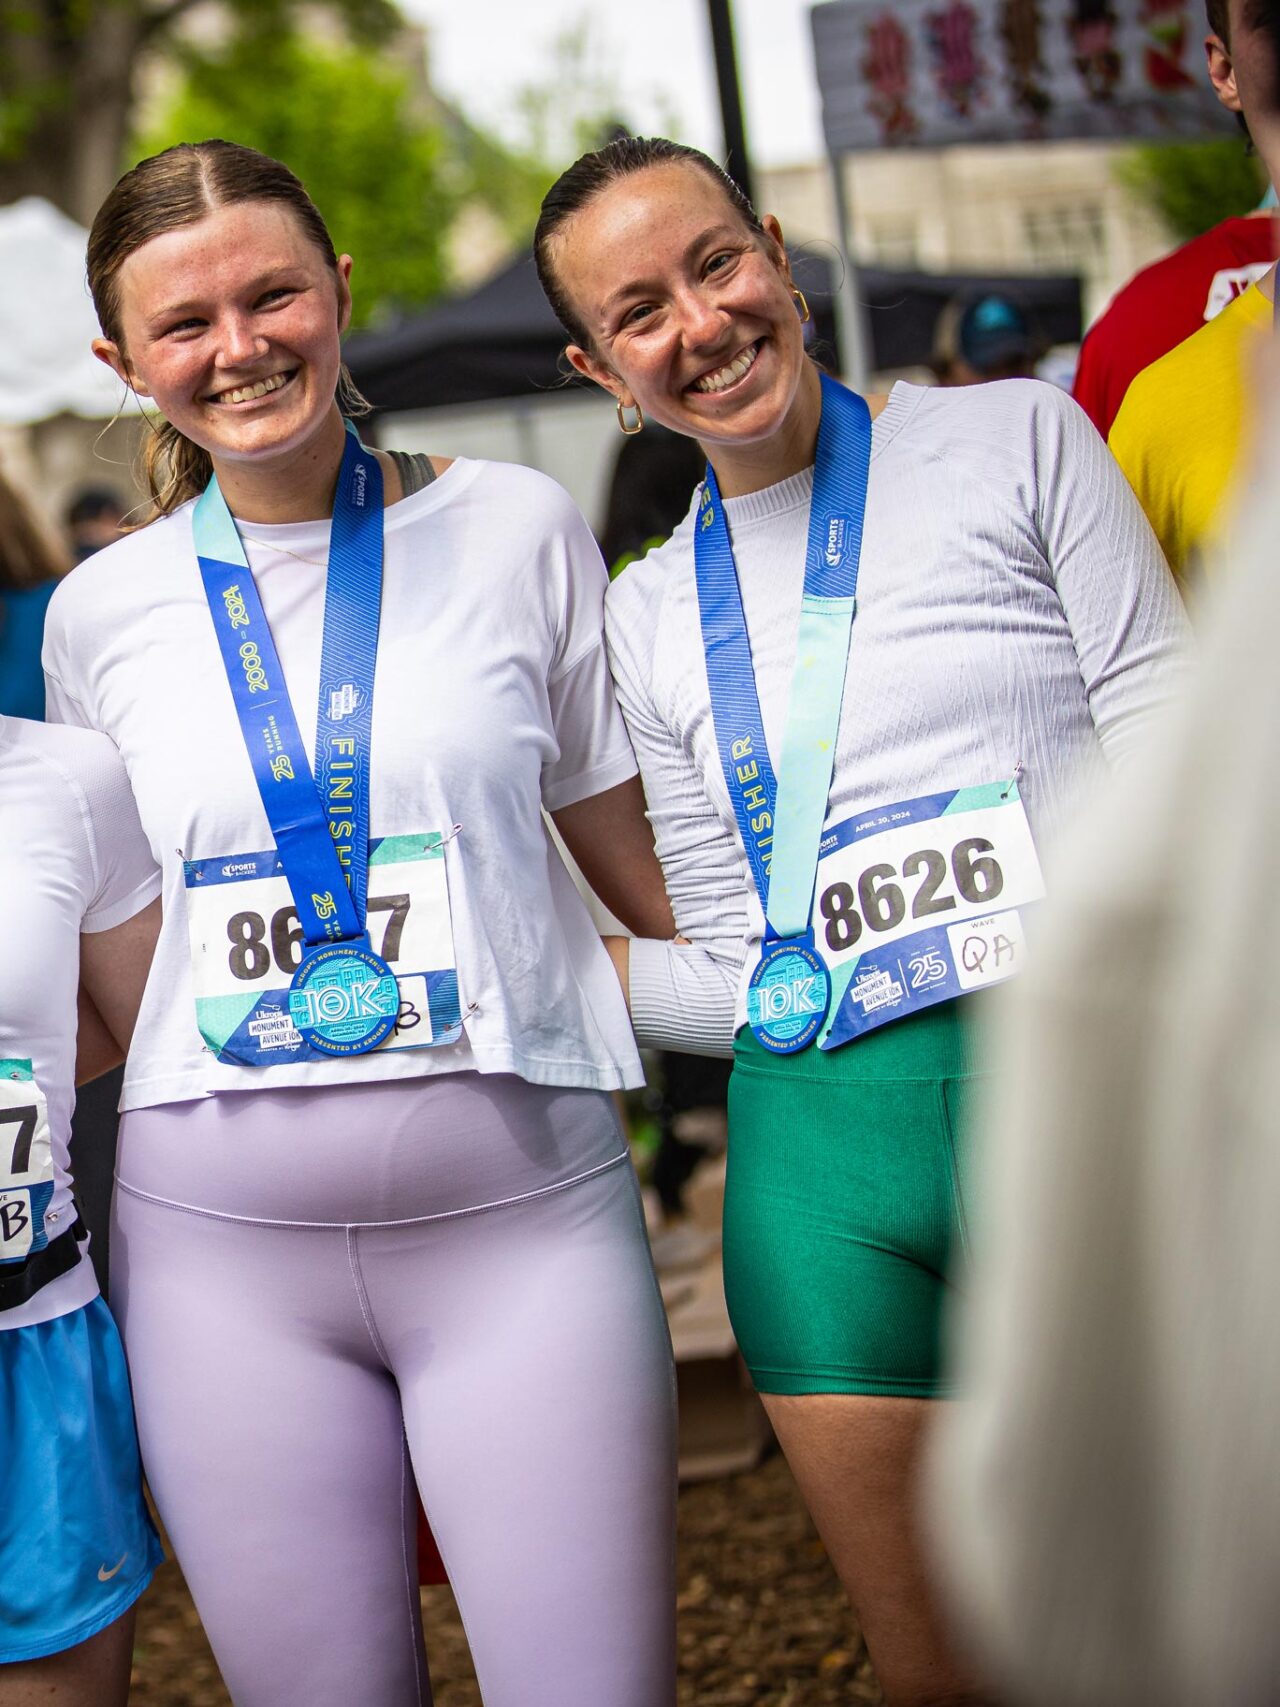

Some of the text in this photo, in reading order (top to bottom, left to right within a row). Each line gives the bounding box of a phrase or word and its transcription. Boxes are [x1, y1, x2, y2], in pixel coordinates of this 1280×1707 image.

[357, 476, 365, 506] SPORTS
[828, 519, 838, 553] SPORTS
[223, 584, 250, 630] 2024
[239, 641, 269, 694] 2000
[262, 728, 274, 754] YEARS
[268, 715, 283, 751] RUNNING
[269, 754, 295, 782] 25
[328, 738, 355, 893] FINISH
[731, 735, 773, 876] ISHER
[855, 811, 911, 833] APRIL 20, 2024
[820, 834, 838, 848] PORTS
[231, 862, 257, 872] SPORTS
[311, 890, 338, 920] 25
[820, 837, 1004, 952] 8626
[227, 893, 411, 980] 867
[971, 918, 996, 929] WAVE
[908, 951, 948, 988] 25
[962, 934, 1016, 973] QA
[303, 979, 387, 1024] 10K
[757, 975, 818, 1021] 10K
[854, 976, 888, 998] MONUMENT
[865, 991, 888, 1006] AVENUE
[251, 1019, 289, 1033] MONUMENT
[395, 1000, 421, 1036] B
[262, 1032, 285, 1044] AVENUE
[310, 1034, 350, 1051] PRESENTED
